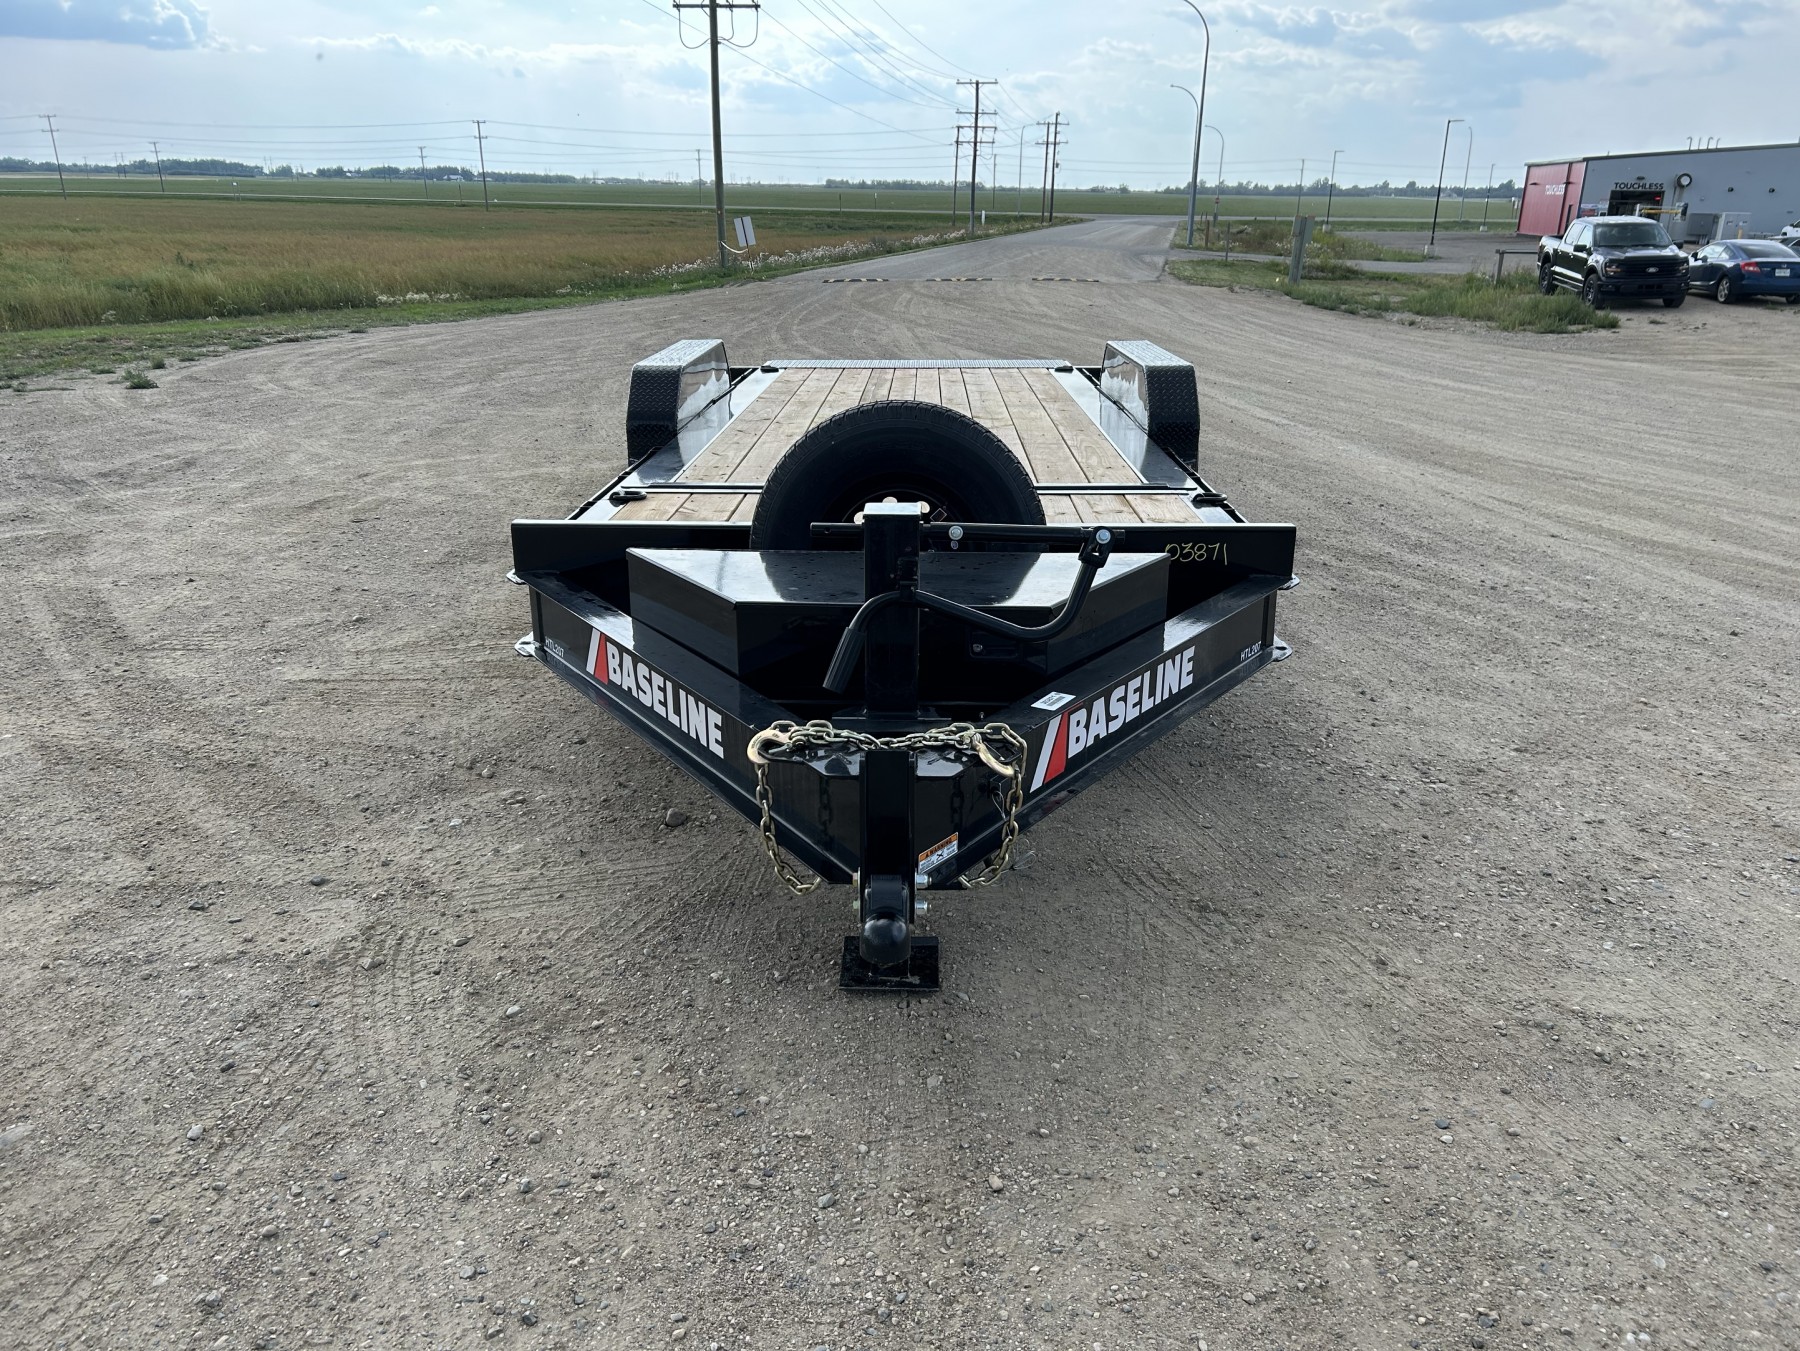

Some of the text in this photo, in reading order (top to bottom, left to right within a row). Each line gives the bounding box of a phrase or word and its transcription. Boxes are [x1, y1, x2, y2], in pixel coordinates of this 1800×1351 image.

[1614, 182, 1664, 190] TOUCHLESS
[1165, 542, 1227, 566] 03871
[1240, 640, 1262, 661] HTL207
[606, 641, 725, 759] BASELINE
[1068, 645, 1196, 759] BASELINE
